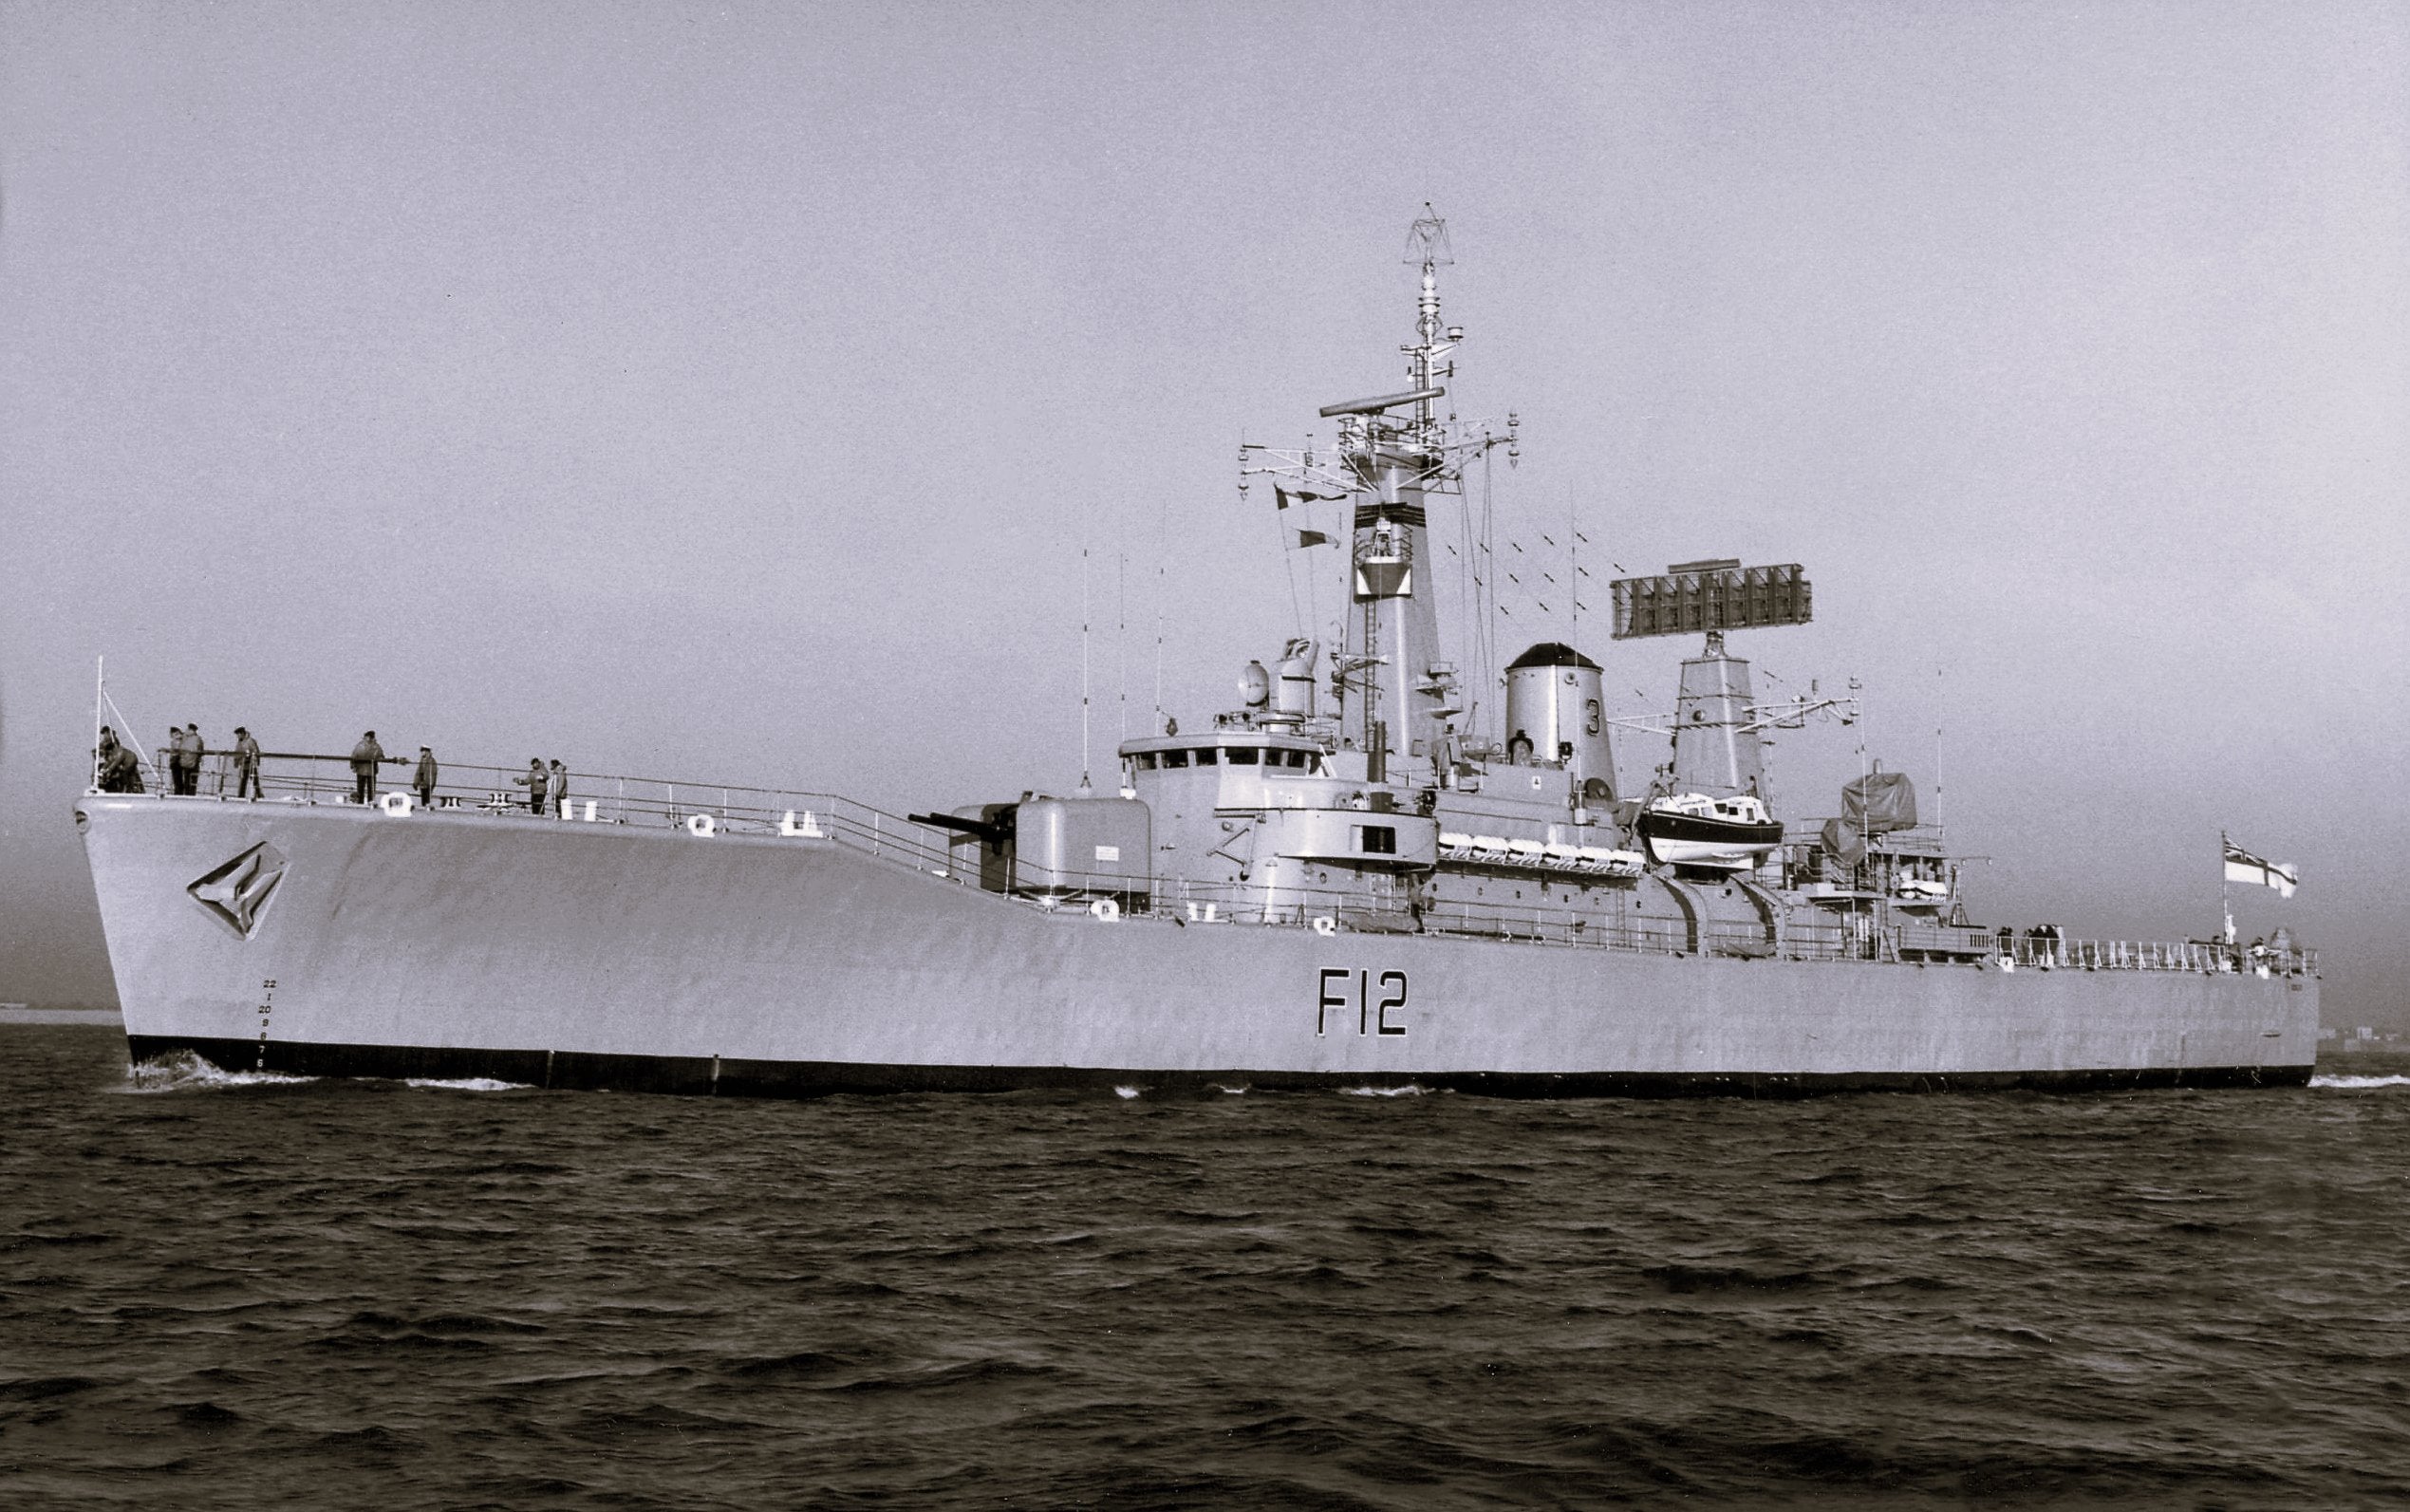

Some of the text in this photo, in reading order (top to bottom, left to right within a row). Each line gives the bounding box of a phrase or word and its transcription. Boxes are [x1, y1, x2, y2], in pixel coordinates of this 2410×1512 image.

[1587, 699, 1599, 737] 3
[263, 980, 276, 988] 22
[1317, 968, 1409, 1036] F12
[259, 1045, 265, 1054] 7
